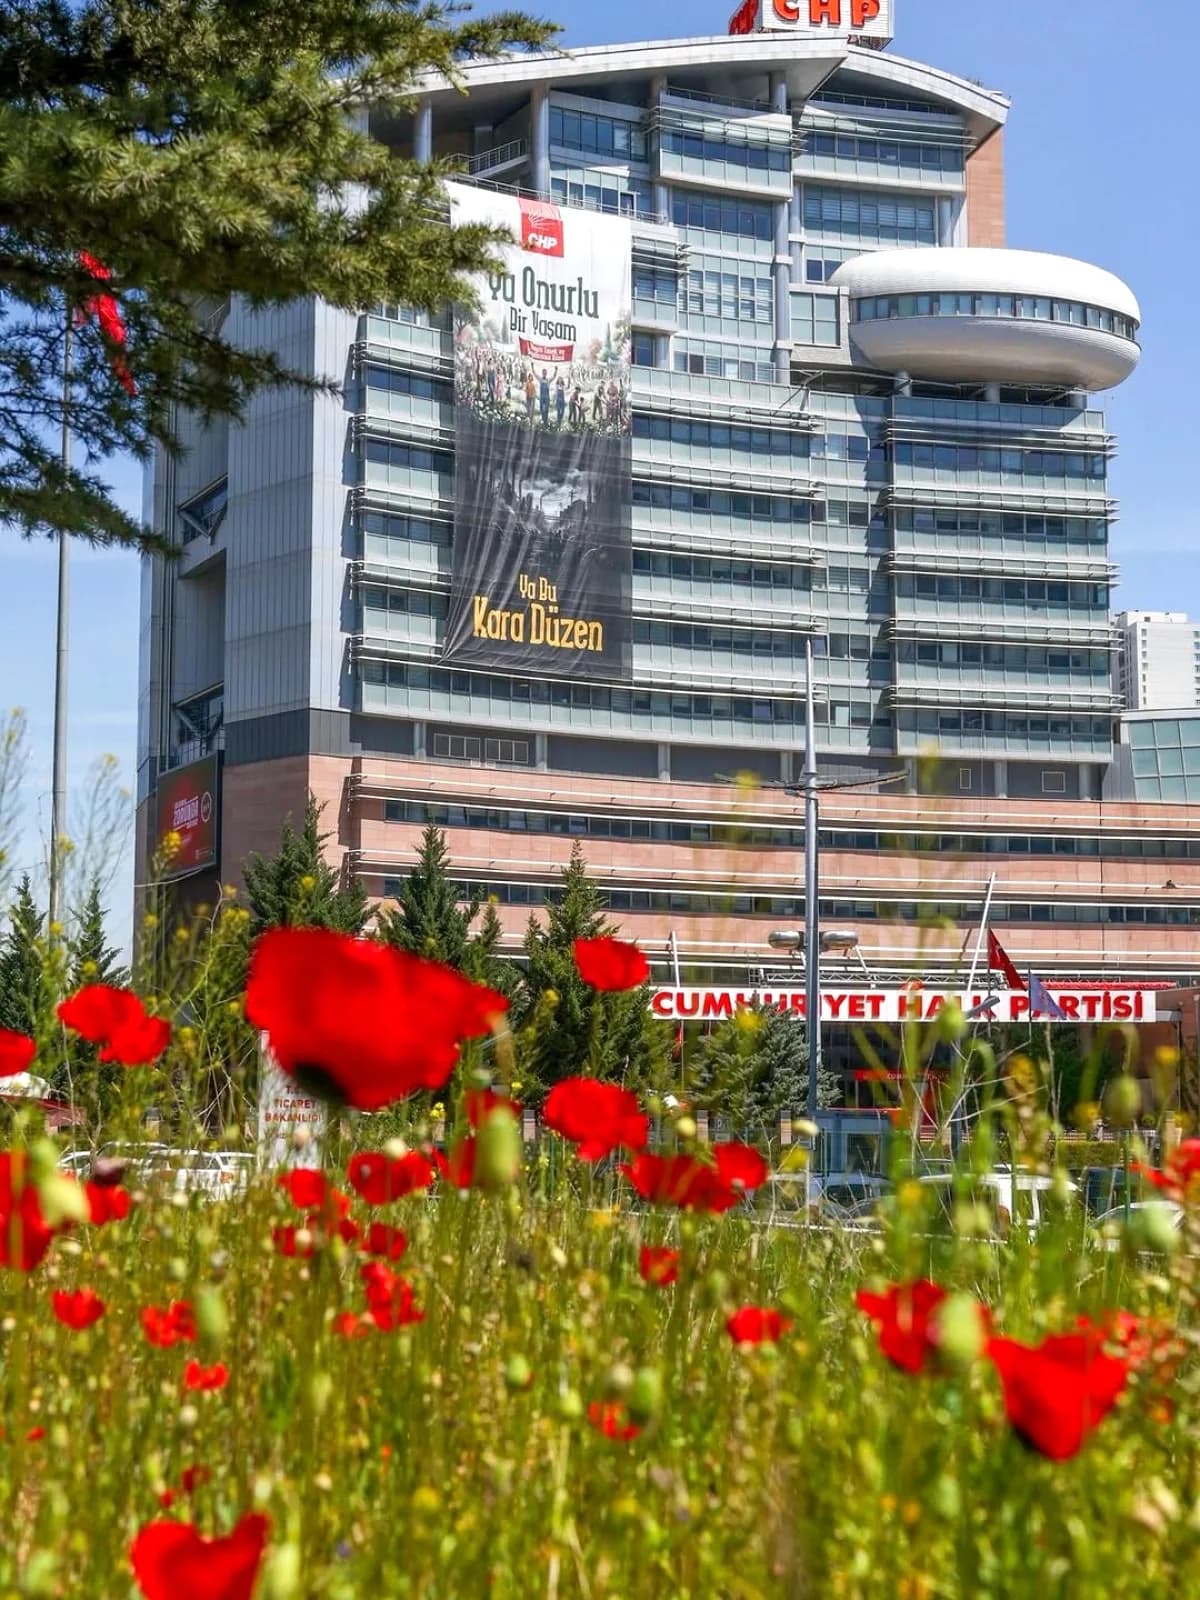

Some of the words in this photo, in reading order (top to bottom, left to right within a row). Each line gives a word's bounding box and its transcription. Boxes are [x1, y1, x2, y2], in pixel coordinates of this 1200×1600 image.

[773, 0, 880, 27] CHP
[528, 232, 558, 250] CHP
[522, 266, 599, 319] Onurlu
[510, 306, 528, 333] Bir
[532, 310, 577, 342] Yaşam
[519, 574, 536, 600] Ya
[539, 577, 557, 602] Bu
[473, 596, 525, 643] Kara
[530, 603, 604, 651] Düzen
[652, 991, 885, 1018] CUMURYET
